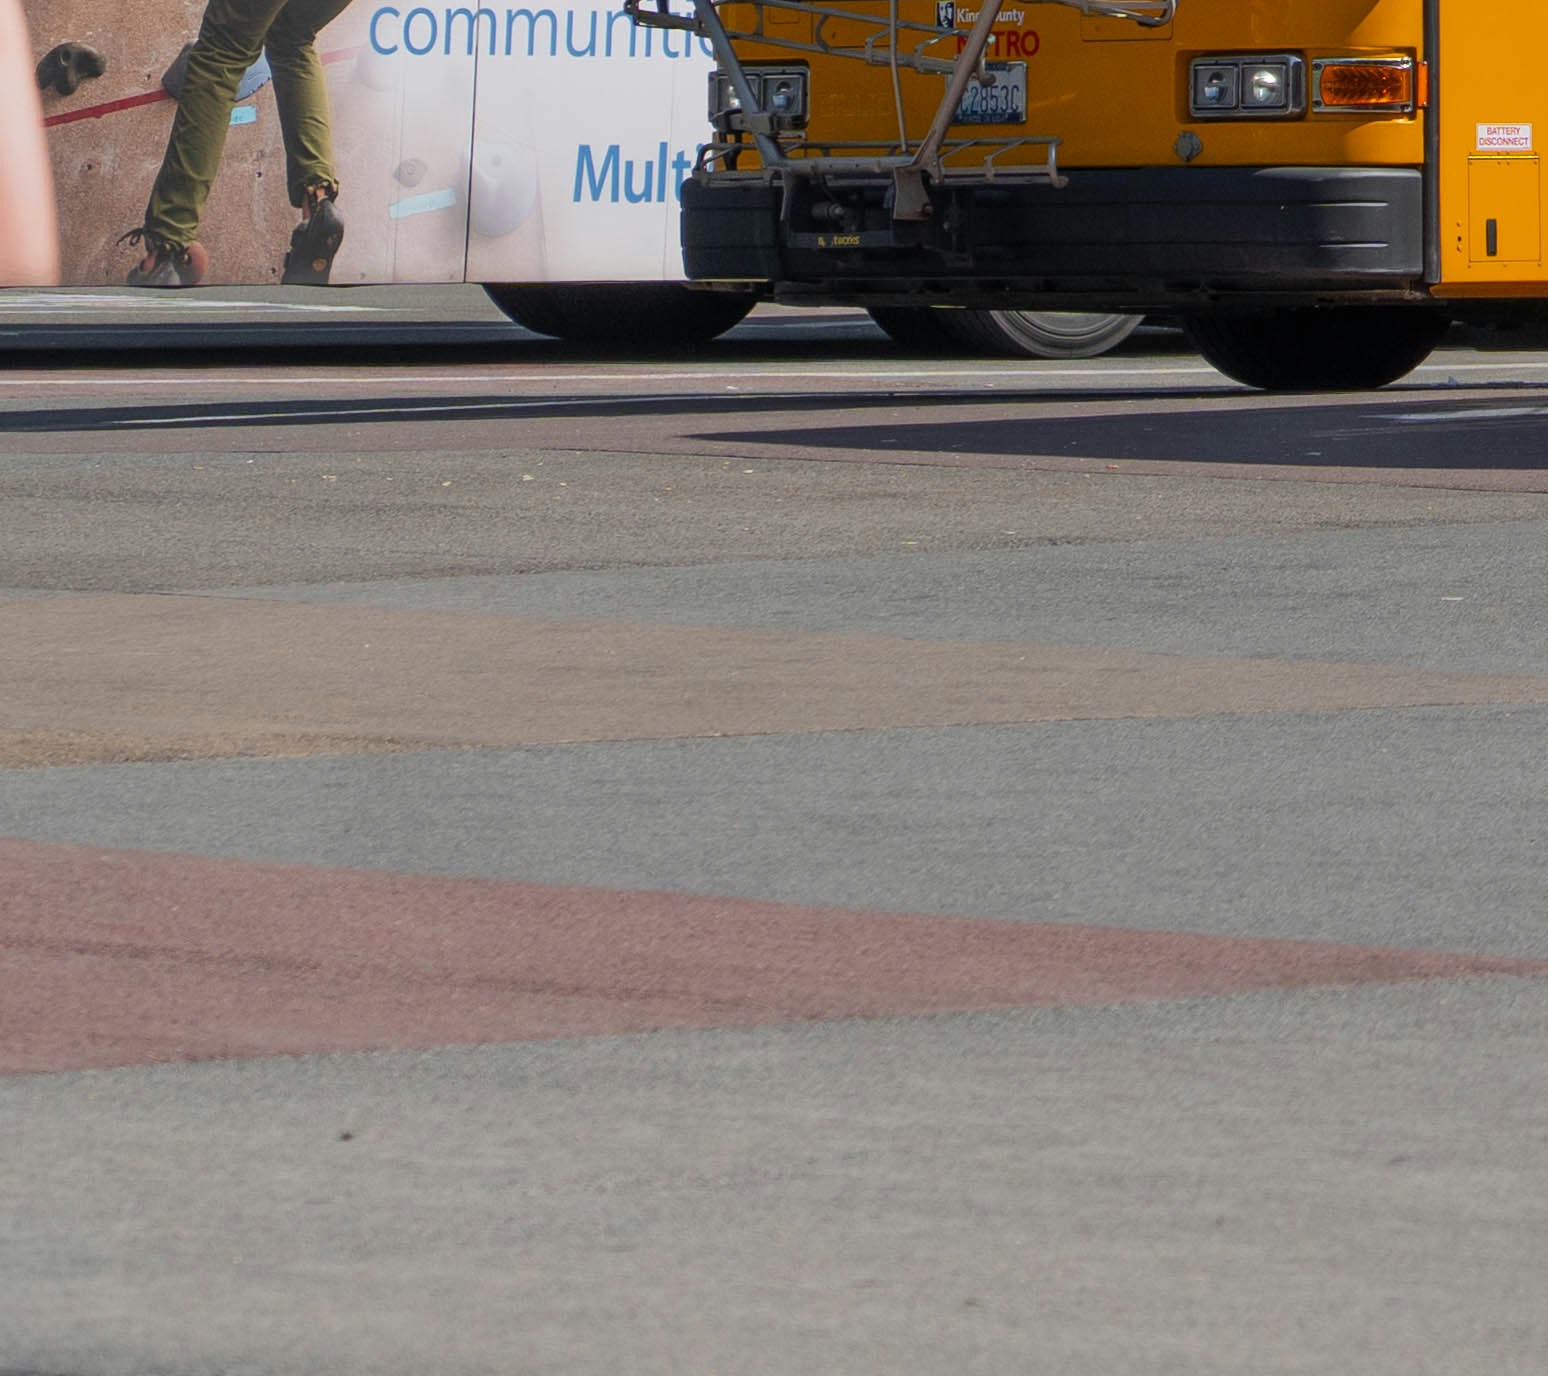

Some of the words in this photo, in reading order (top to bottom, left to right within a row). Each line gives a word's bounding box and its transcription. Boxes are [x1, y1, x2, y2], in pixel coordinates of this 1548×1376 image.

[1487, 127, 1521, 136] BATTERY
[1479, 137, 1529, 146] DISCONNECT
[573, 141, 713, 204] Mult
